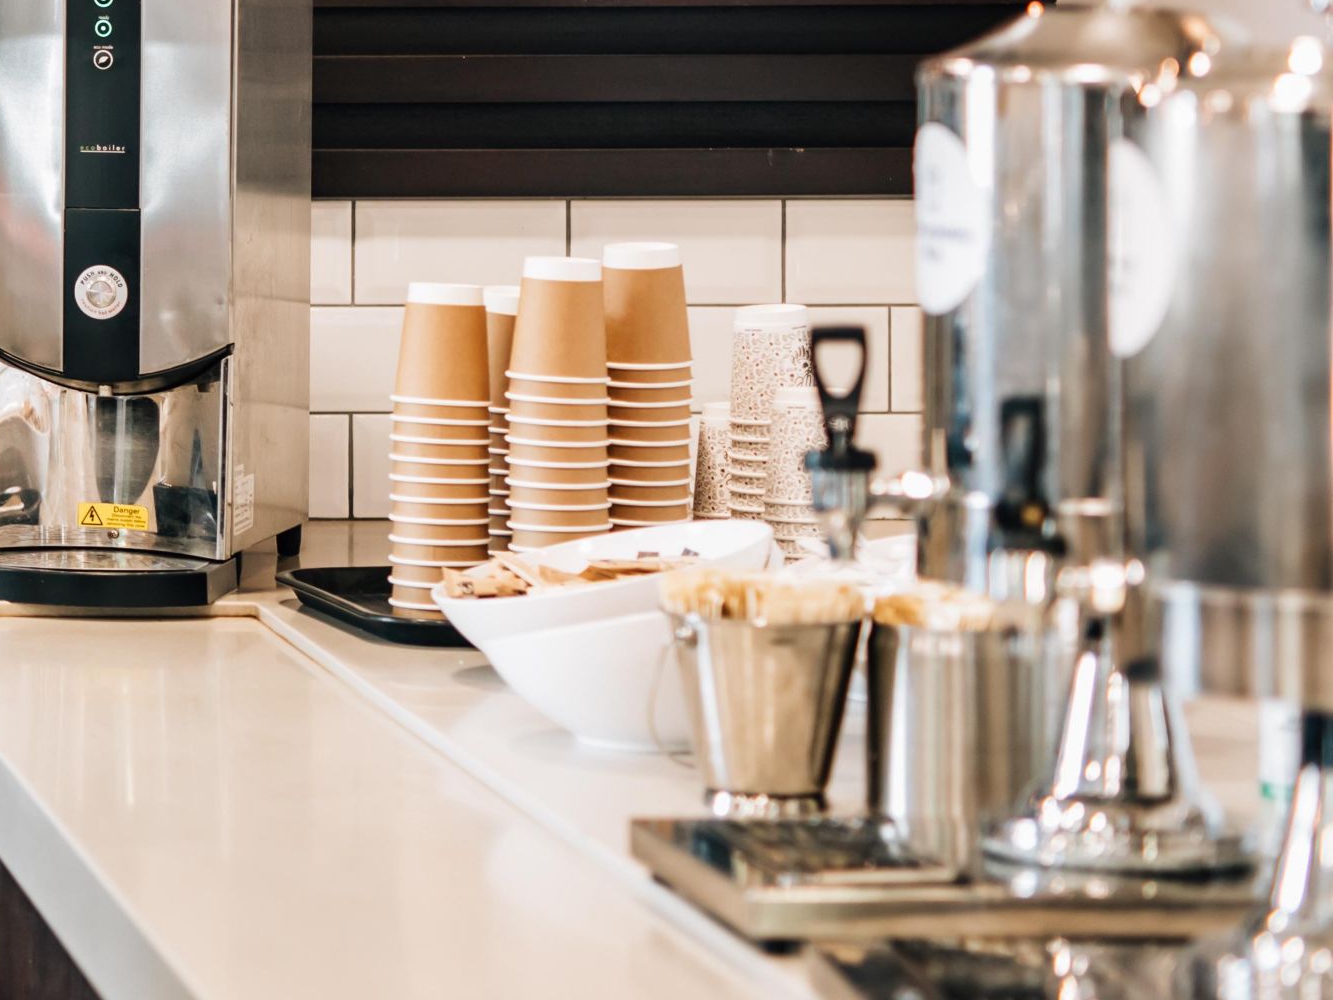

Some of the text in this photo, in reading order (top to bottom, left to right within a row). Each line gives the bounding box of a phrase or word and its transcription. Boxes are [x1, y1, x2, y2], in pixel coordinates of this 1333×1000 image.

[80, 143, 126, 152] ecoboiler
[80, 270, 95, 286] PUSH
[109, 272, 123, 288] HOLD
[113, 505, 140, 515] Danger
